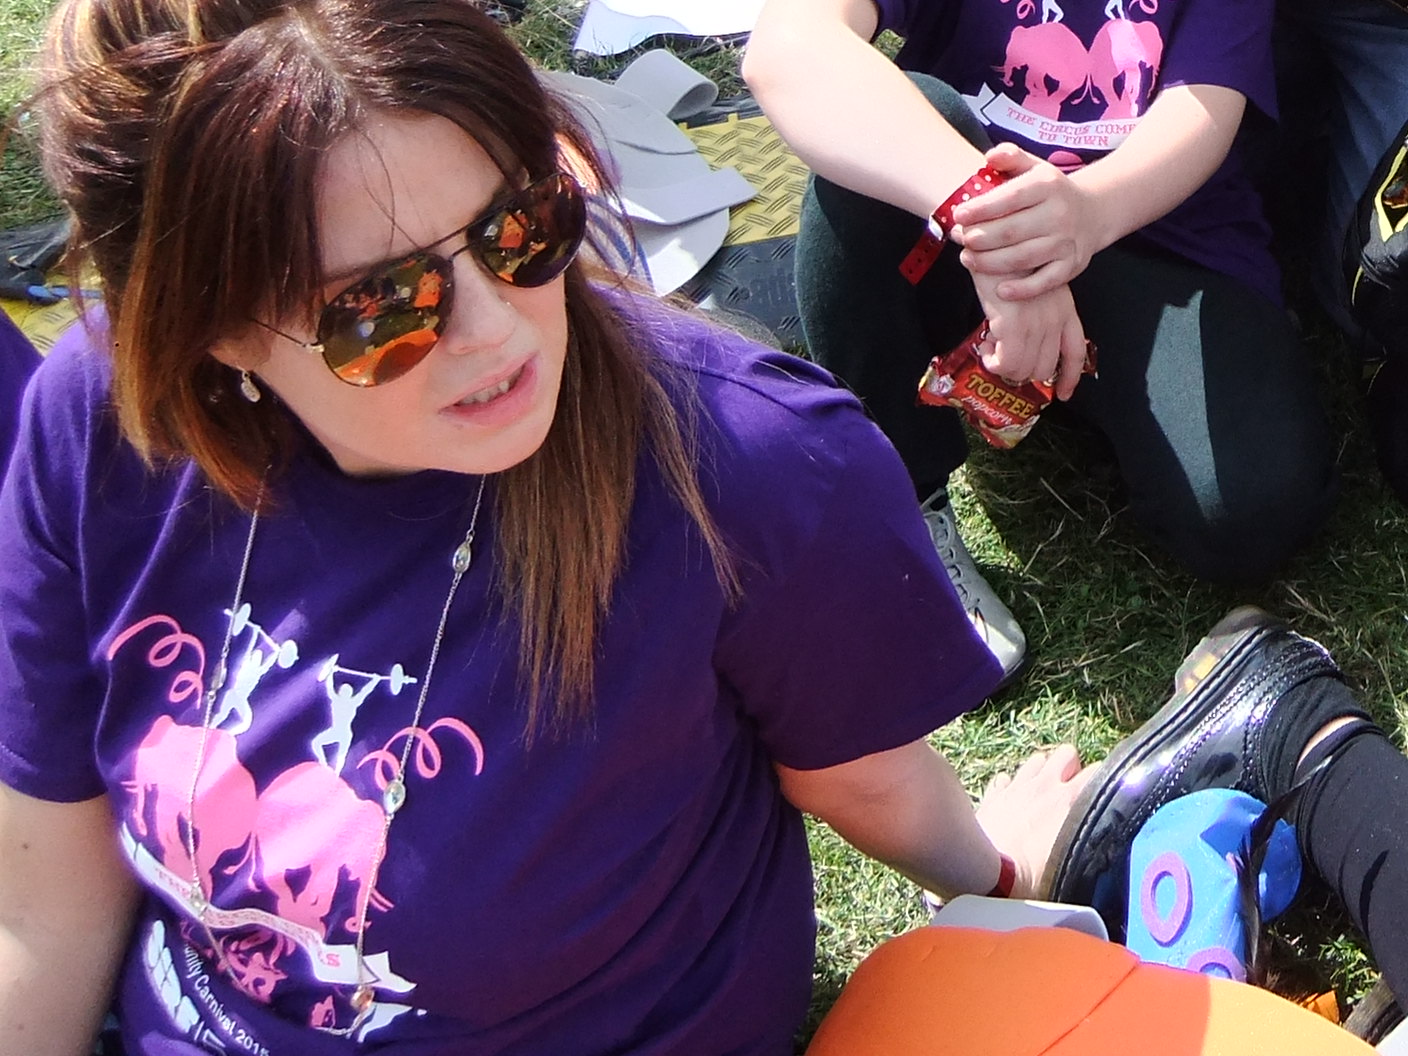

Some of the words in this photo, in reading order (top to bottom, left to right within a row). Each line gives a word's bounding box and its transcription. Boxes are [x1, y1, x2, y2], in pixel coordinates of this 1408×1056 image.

[1007, 107, 1037, 125] THE
[1040, 121, 1091, 136] CIRCUS
[1095, 123, 1137, 135] COME
[1039, 130, 1057, 141] TO
[1063, 135, 1109, 146] TOWN
[961, 395, 1013, 425] popcorn
[967, 373, 1035, 419] TOFFEE
[194, 974, 237, 1036] Carnival
